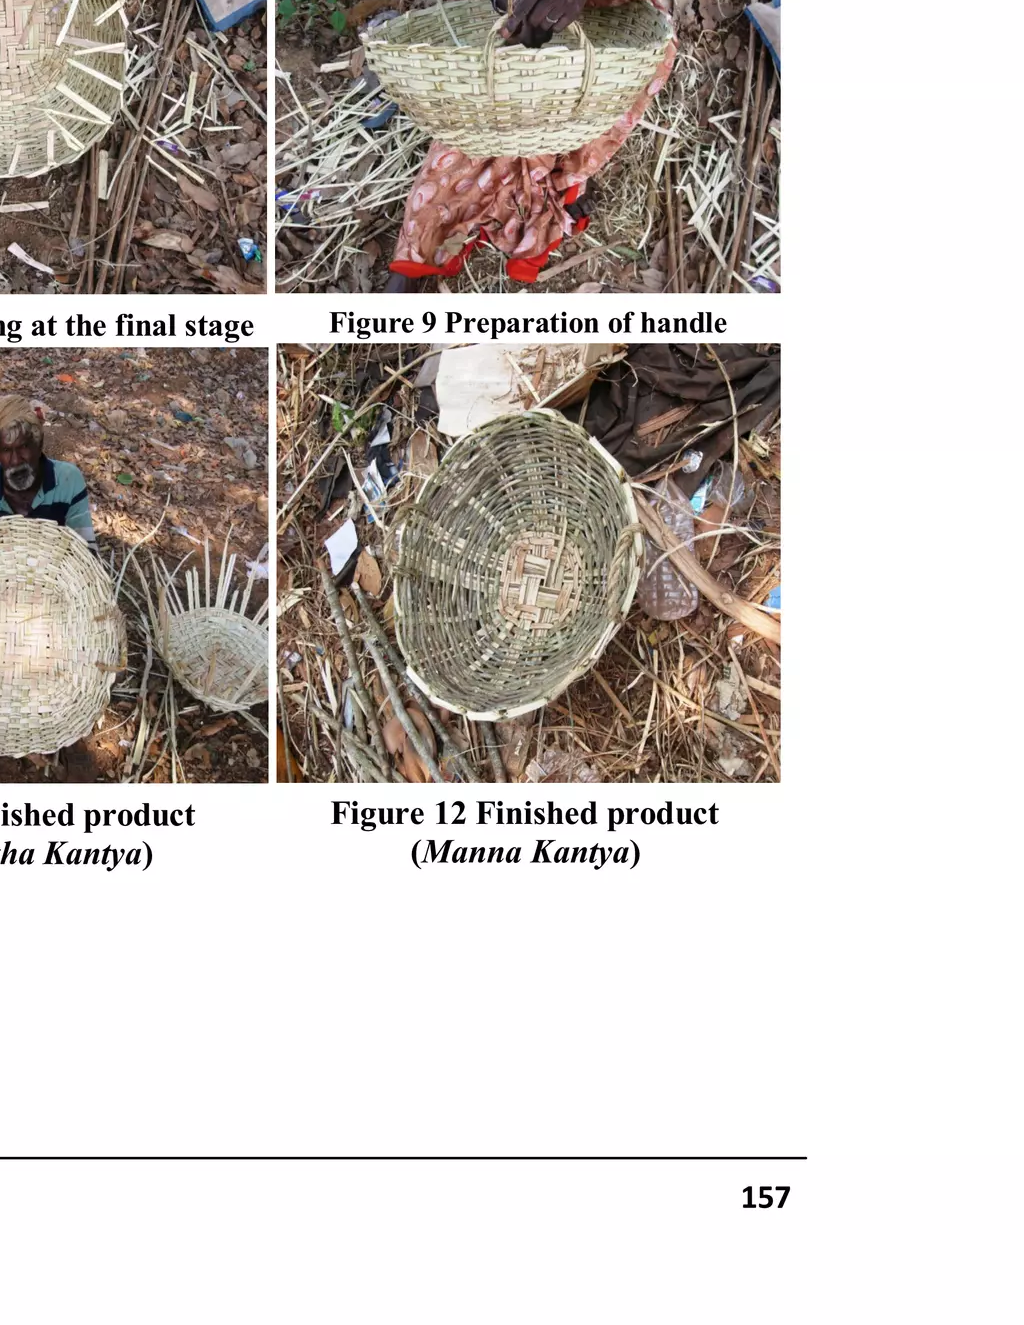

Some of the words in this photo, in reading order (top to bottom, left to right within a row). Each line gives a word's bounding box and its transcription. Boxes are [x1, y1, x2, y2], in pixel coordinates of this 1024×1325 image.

[31, 315, 58, 337] at
[65, 313, 107, 337] the
[115, 313, 177, 337] final
[185, 315, 254, 344] stage
[329, 311, 415, 340] Figure
[422, 311, 437, 334] 9
[444, 311, 599, 340] Preparation
[608, 311, 636, 334] of
[640, 311, 727, 334] handle
[83, 802, 196, 834] product
[330, 800, 425, 832] Figure
[435, 800, 467, 825] 12
[475, 800, 598, 825] Finished
[607, 800, 720, 832] product
[42, 840, 153, 872] Kantya)
[411, 839, 522, 870] (Manna
[529, 839, 641, 871] Kantya)
[742, 1185, 791, 1209] 157
